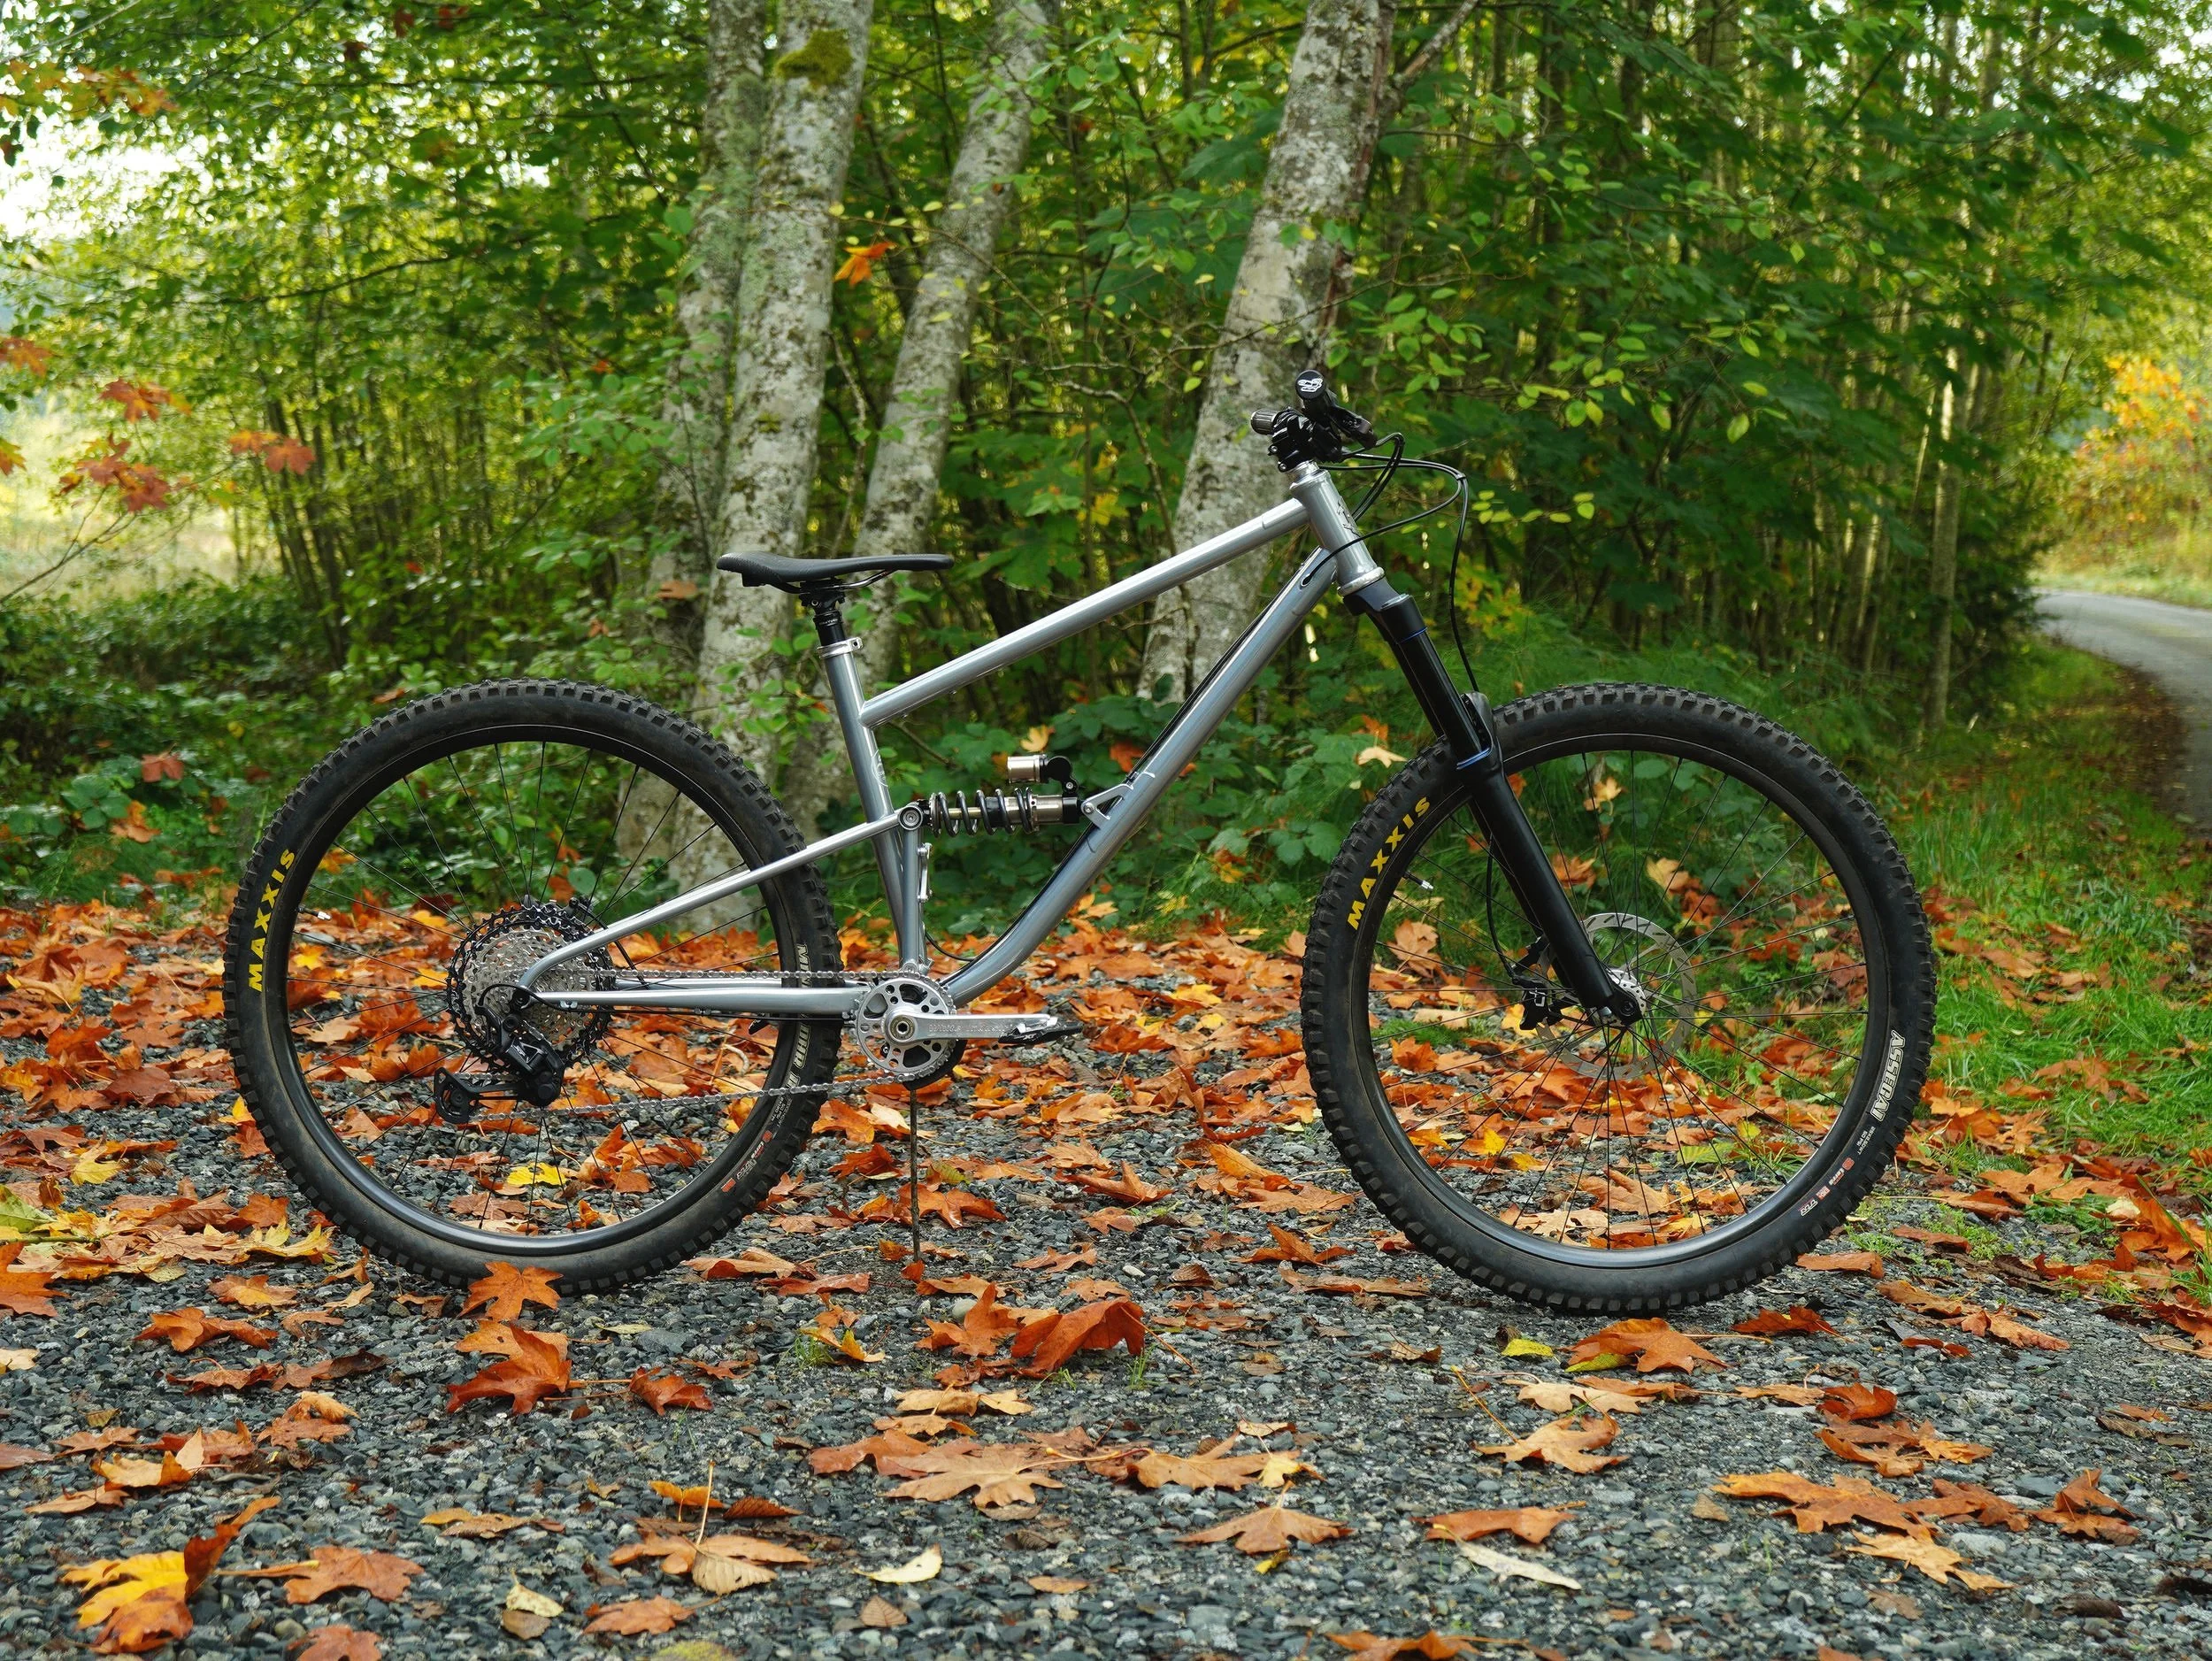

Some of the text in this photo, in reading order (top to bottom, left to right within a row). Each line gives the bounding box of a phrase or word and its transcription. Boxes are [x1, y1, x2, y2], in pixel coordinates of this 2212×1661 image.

[1348, 796, 1431, 930] MAXXIS
[249, 849, 295, 992] MAXXIS
[793, 1024, 811, 1069] DHR
[1870, 1029, 1906, 1122] ASSEGAI
